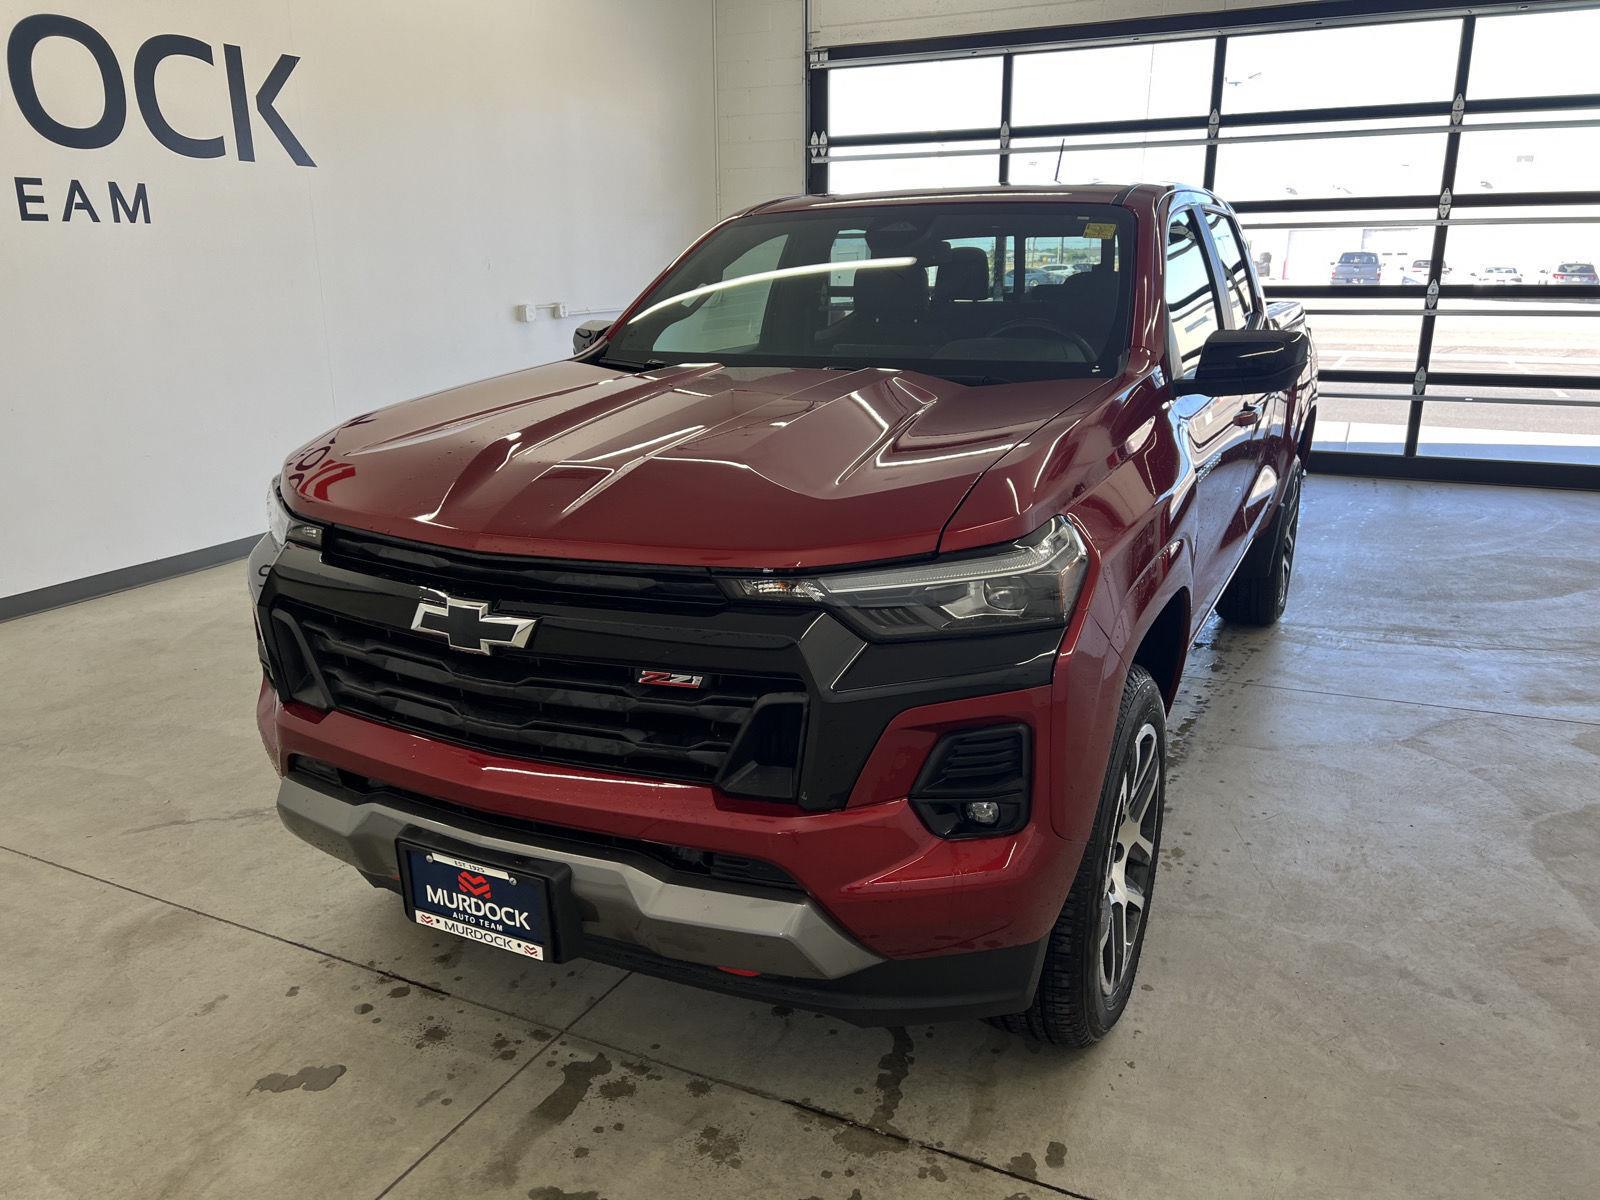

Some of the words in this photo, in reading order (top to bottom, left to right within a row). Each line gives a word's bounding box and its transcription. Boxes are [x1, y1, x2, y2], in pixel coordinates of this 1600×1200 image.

[7, 13, 318, 168] OCK
[14, 176, 152, 224] EAM
[638, 670, 703, 689] Z71
[426, 885, 531, 930] MURDOCK
[452, 911, 476, 924] AUTO
[479, 918, 503, 932] TEAM
[444, 920, 513, 950] MURDOCK
